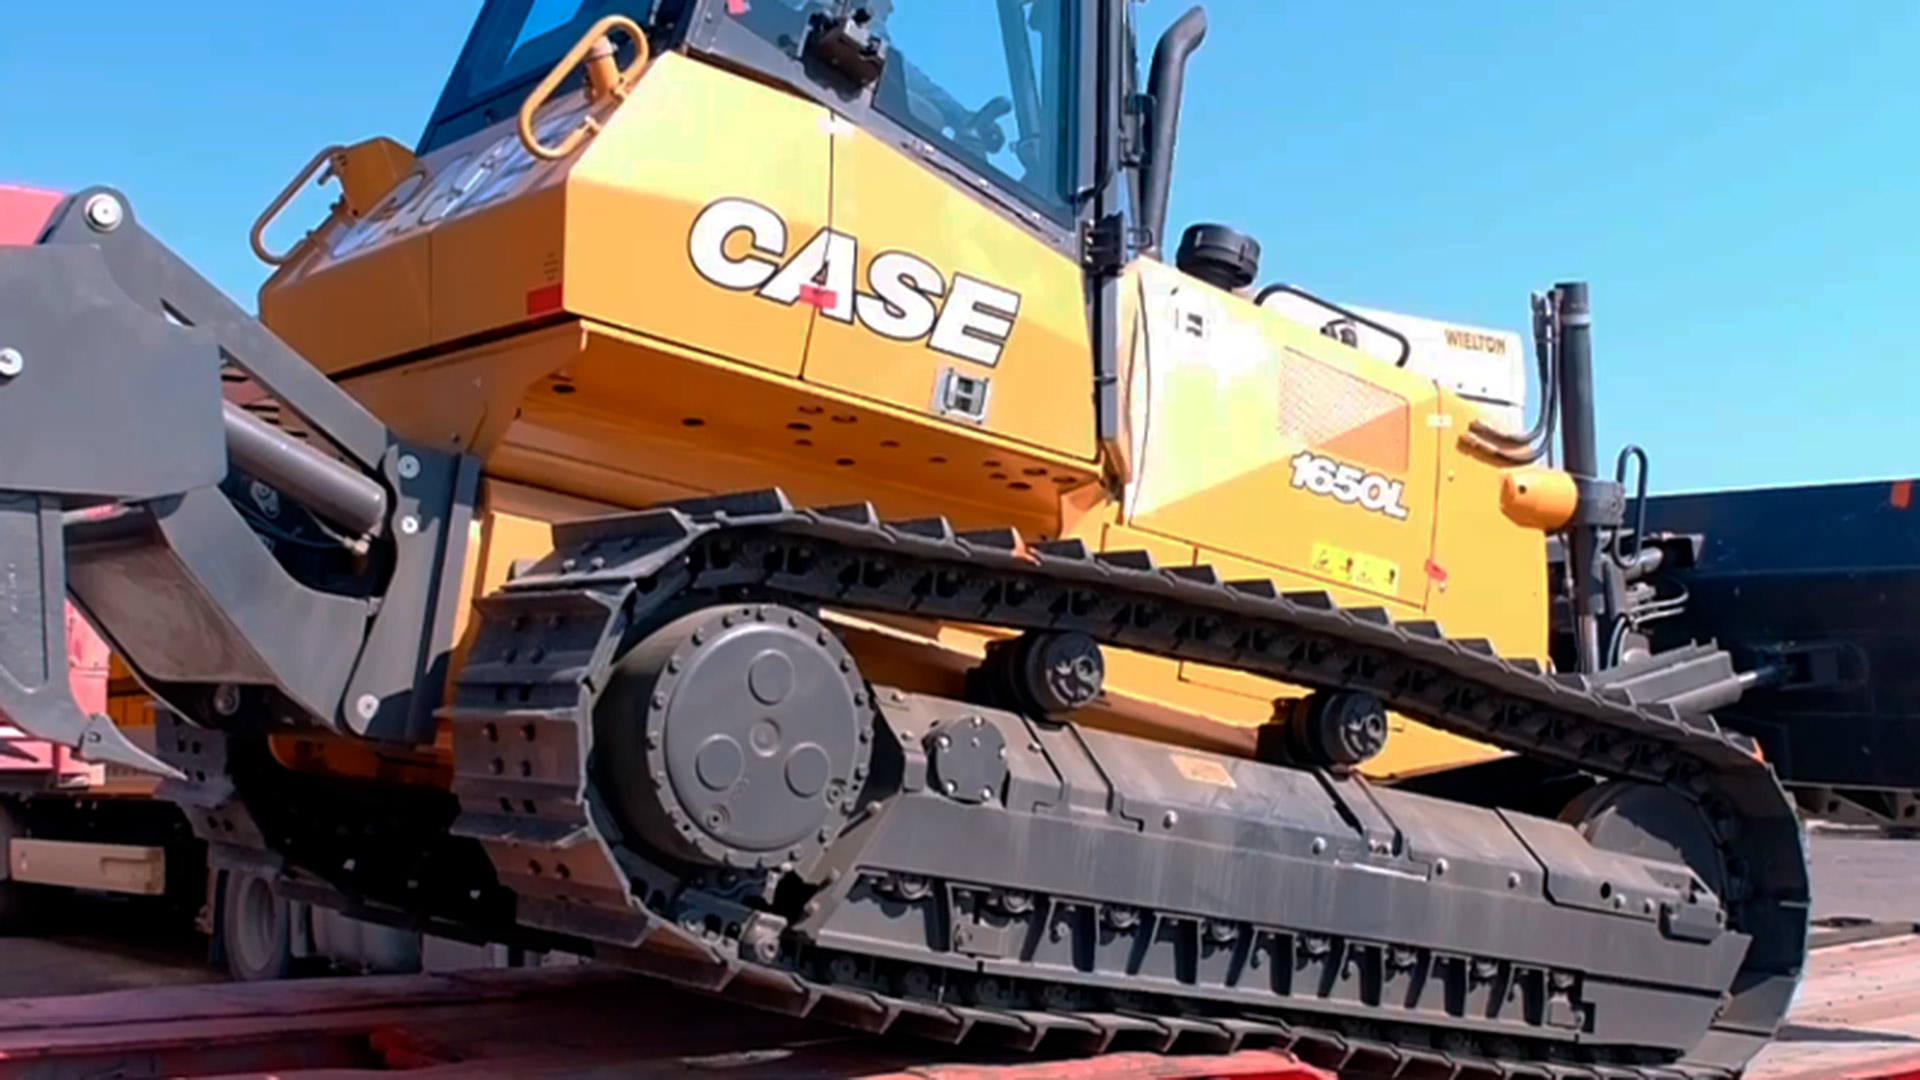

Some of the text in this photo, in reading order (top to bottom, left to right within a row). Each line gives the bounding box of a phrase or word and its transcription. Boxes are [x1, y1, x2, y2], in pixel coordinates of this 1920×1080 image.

[688, 198, 1021, 367] CASE
[1444, 328, 1506, 357] WIELTON
[1289, 450, 1409, 521] 1650L
